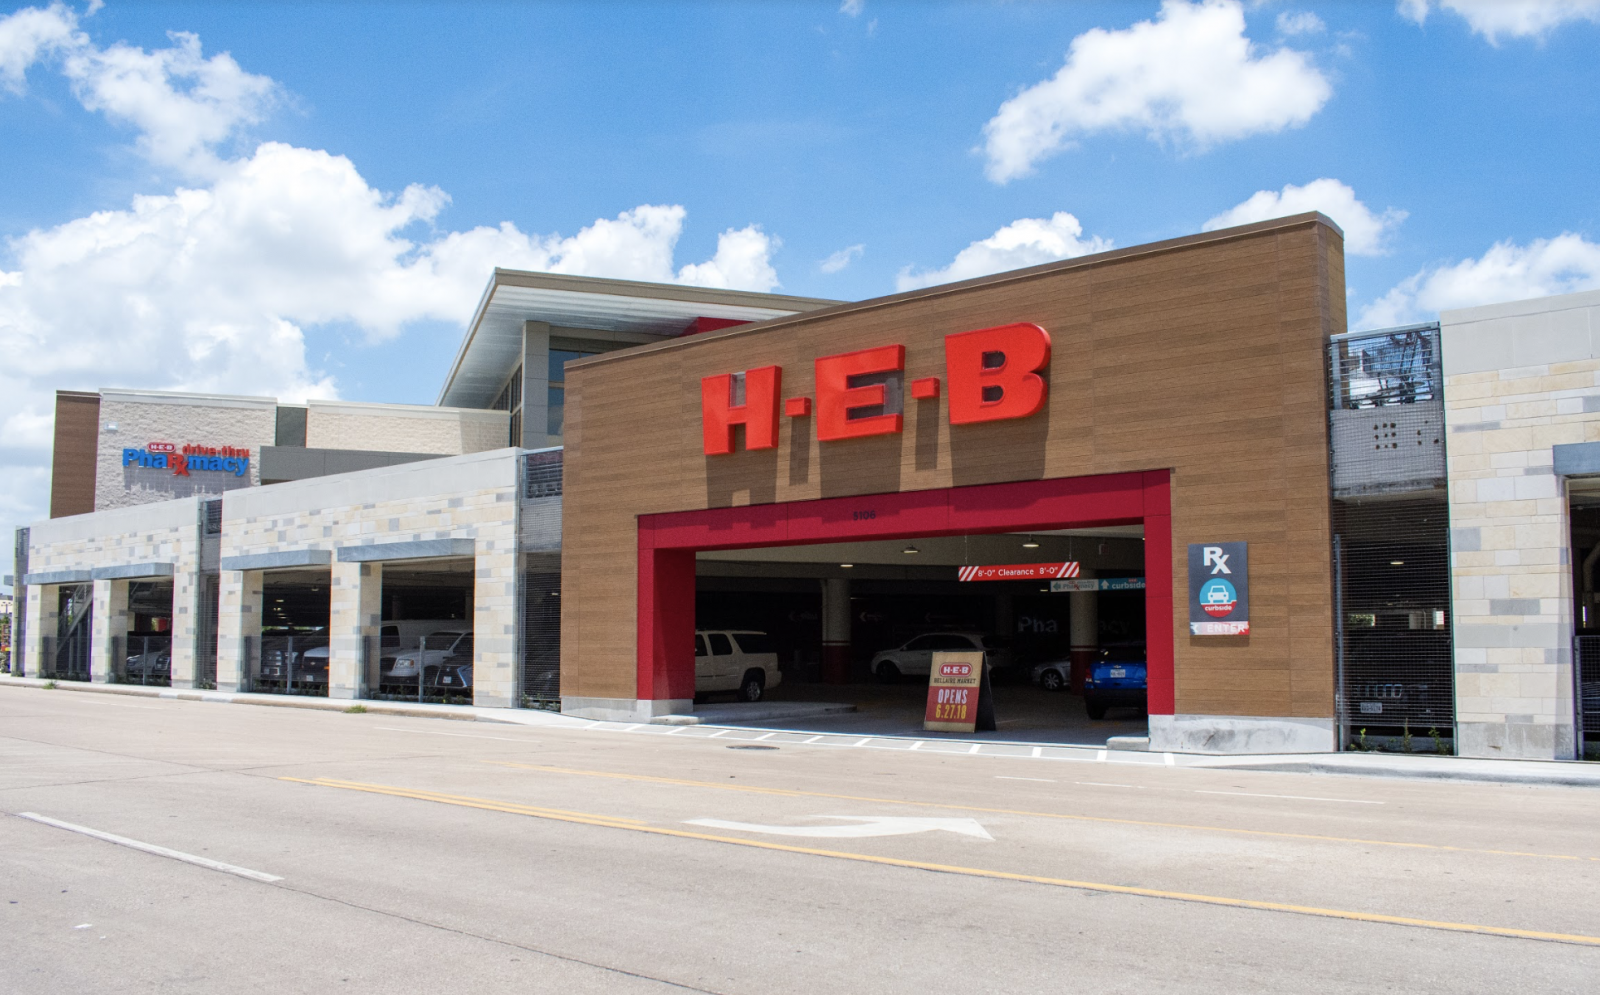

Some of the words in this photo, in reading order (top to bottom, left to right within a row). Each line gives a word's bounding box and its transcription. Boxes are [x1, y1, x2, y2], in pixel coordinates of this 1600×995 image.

[182, 443, 250, 458] drive-thru
[853, 510, 876, 521] 5106
[998, 568, 1035, 577] Clearance
[1207, 624, 1246, 633] ENTER
[937, 688, 968, 705] OPENS
[935, 703, 967, 720] 6.27.18
